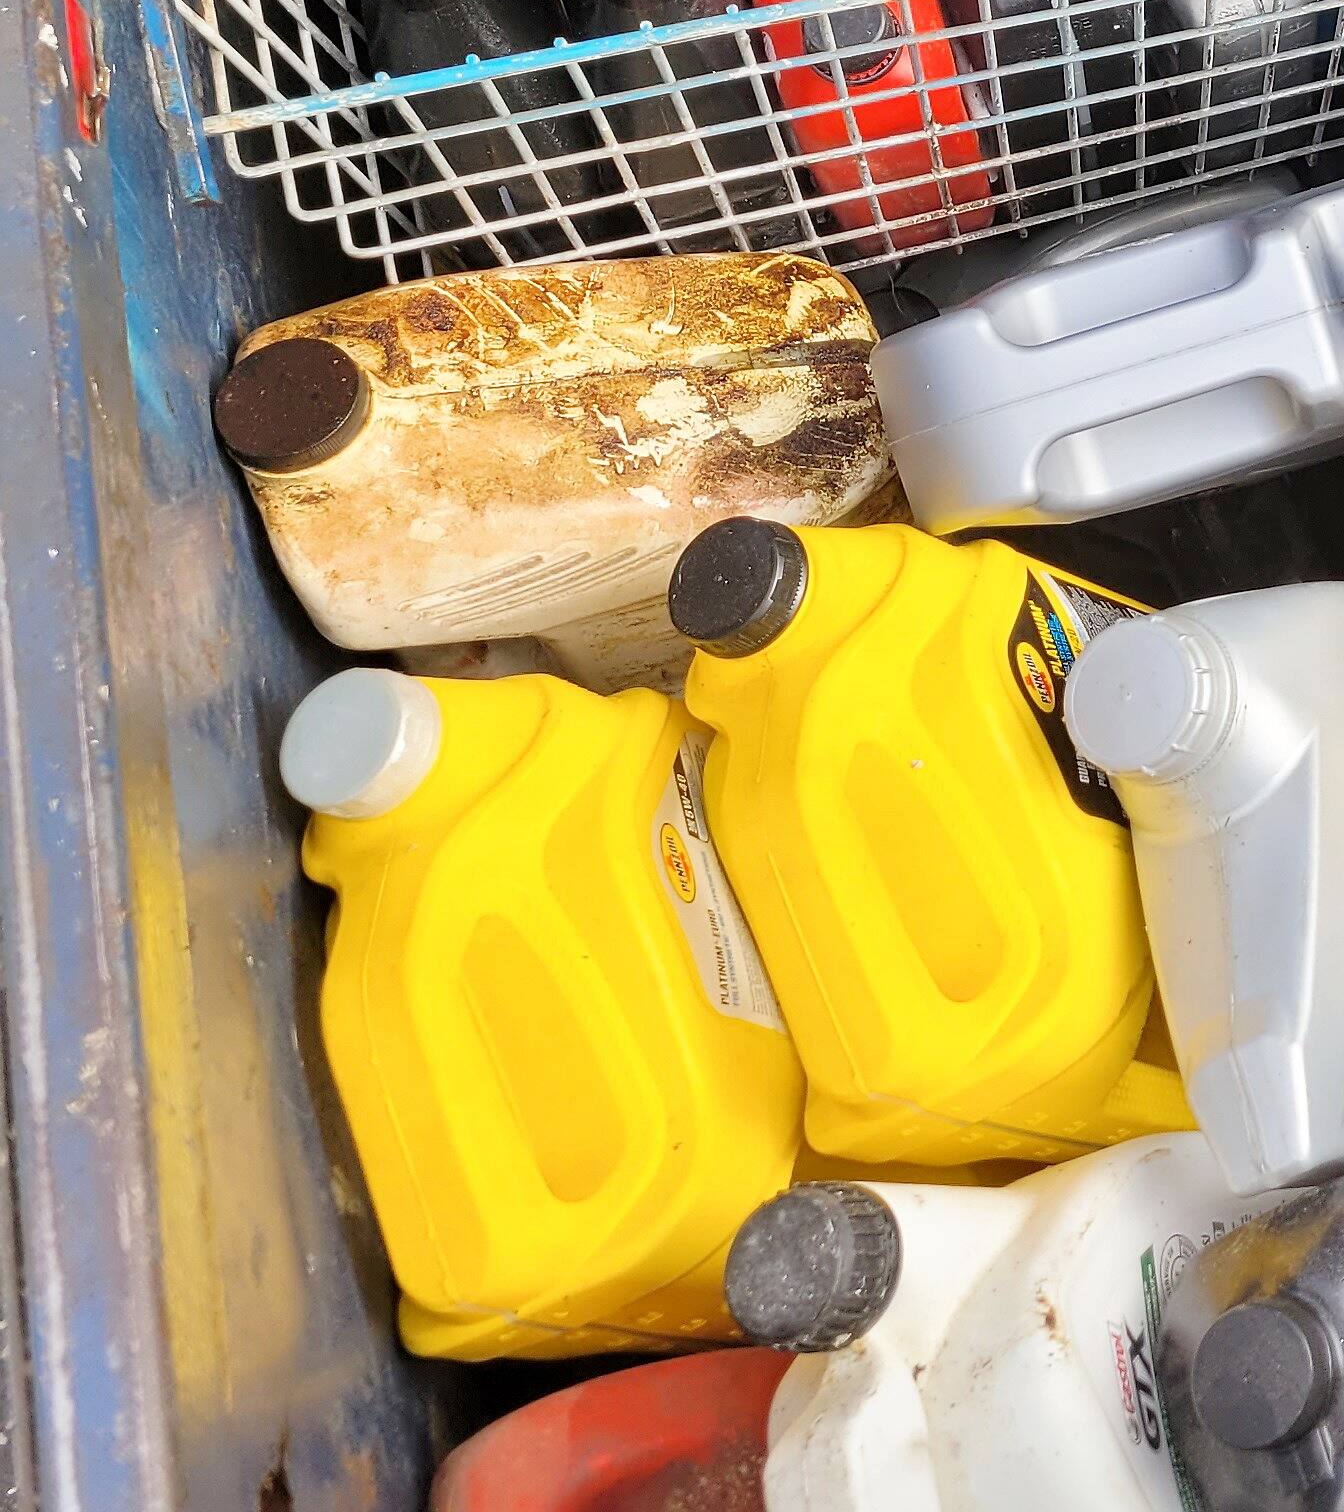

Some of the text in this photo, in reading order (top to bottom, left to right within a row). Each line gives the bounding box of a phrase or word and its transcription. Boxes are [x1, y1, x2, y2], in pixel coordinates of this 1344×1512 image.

[1028, 601, 1065, 679] PLATINUM
[1023, 653, 1051, 704] PENNZOIL
[665, 834, 690, 894] PENNZOIL
[712, 945, 731, 1006] PLATINUM
[1123, 1316, 1161, 1450] GTX
